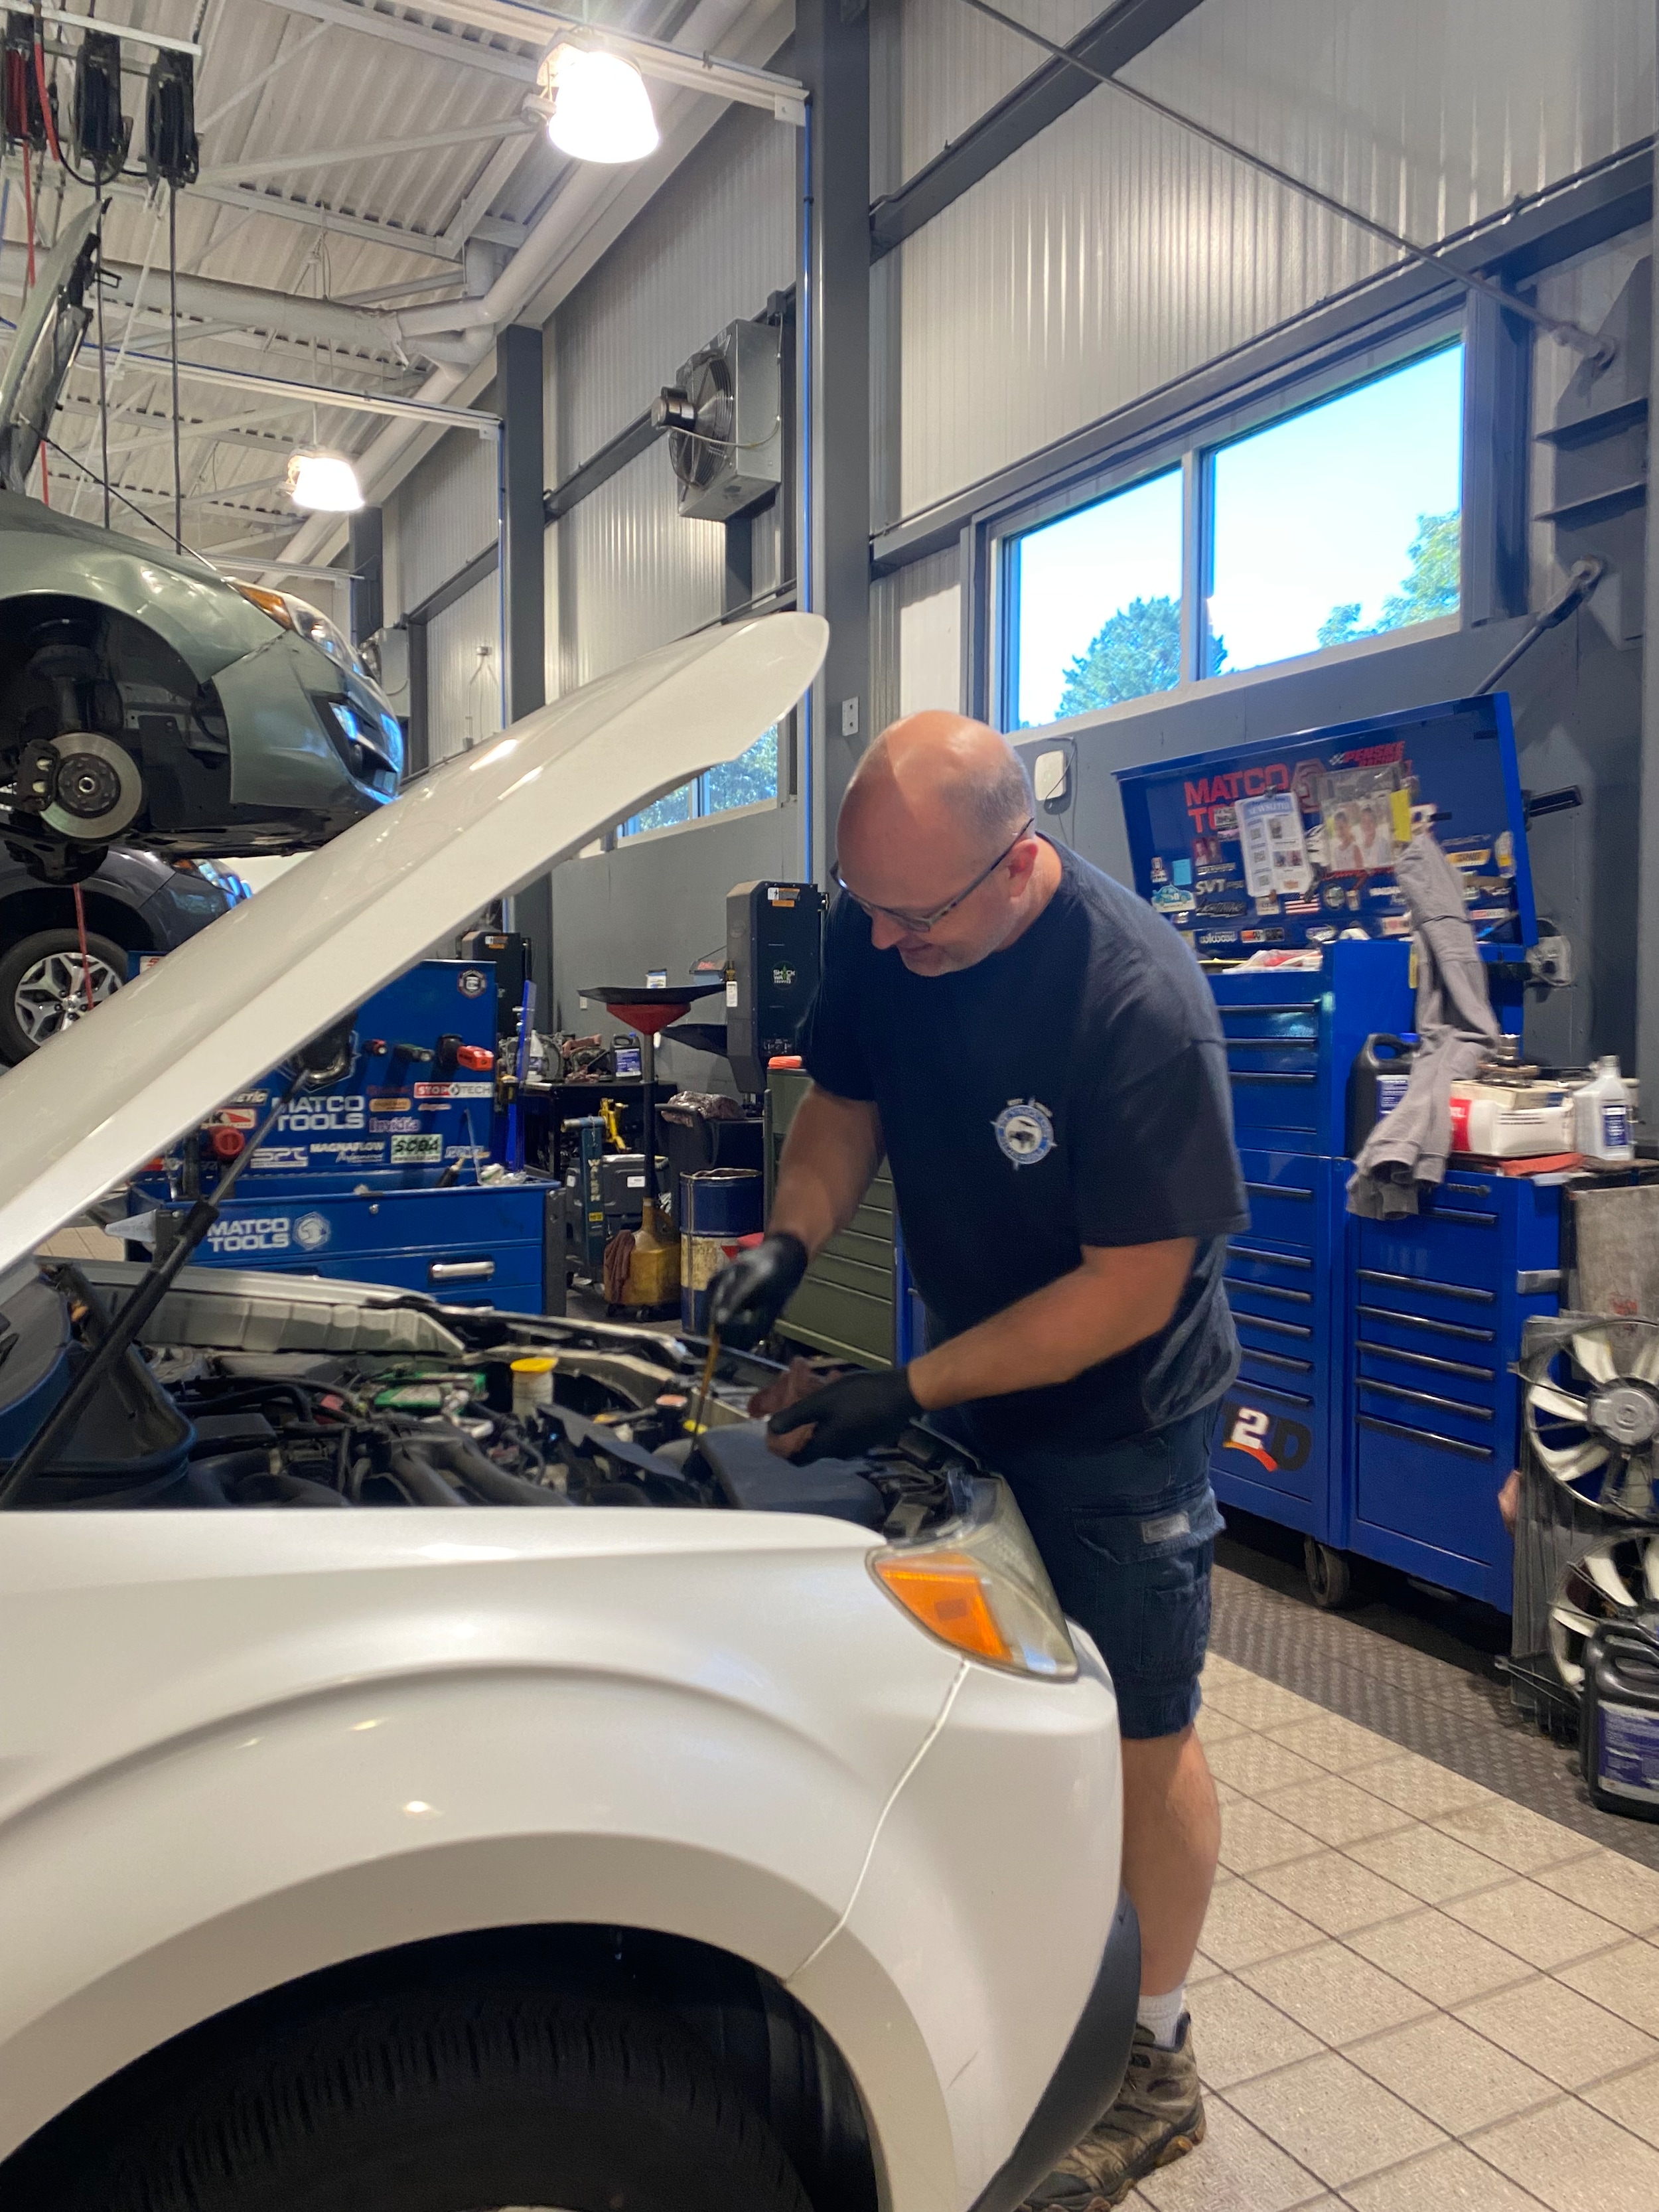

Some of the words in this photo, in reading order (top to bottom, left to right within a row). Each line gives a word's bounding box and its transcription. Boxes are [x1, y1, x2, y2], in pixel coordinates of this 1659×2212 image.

[1184, 764, 1289, 807] MATCO
[1195, 879, 1225, 896] SVT
[277, 1112, 364, 1132] TOOLS
[207, 1217, 290, 1237] MATCO
[207, 1233, 290, 1252] TOOLS
